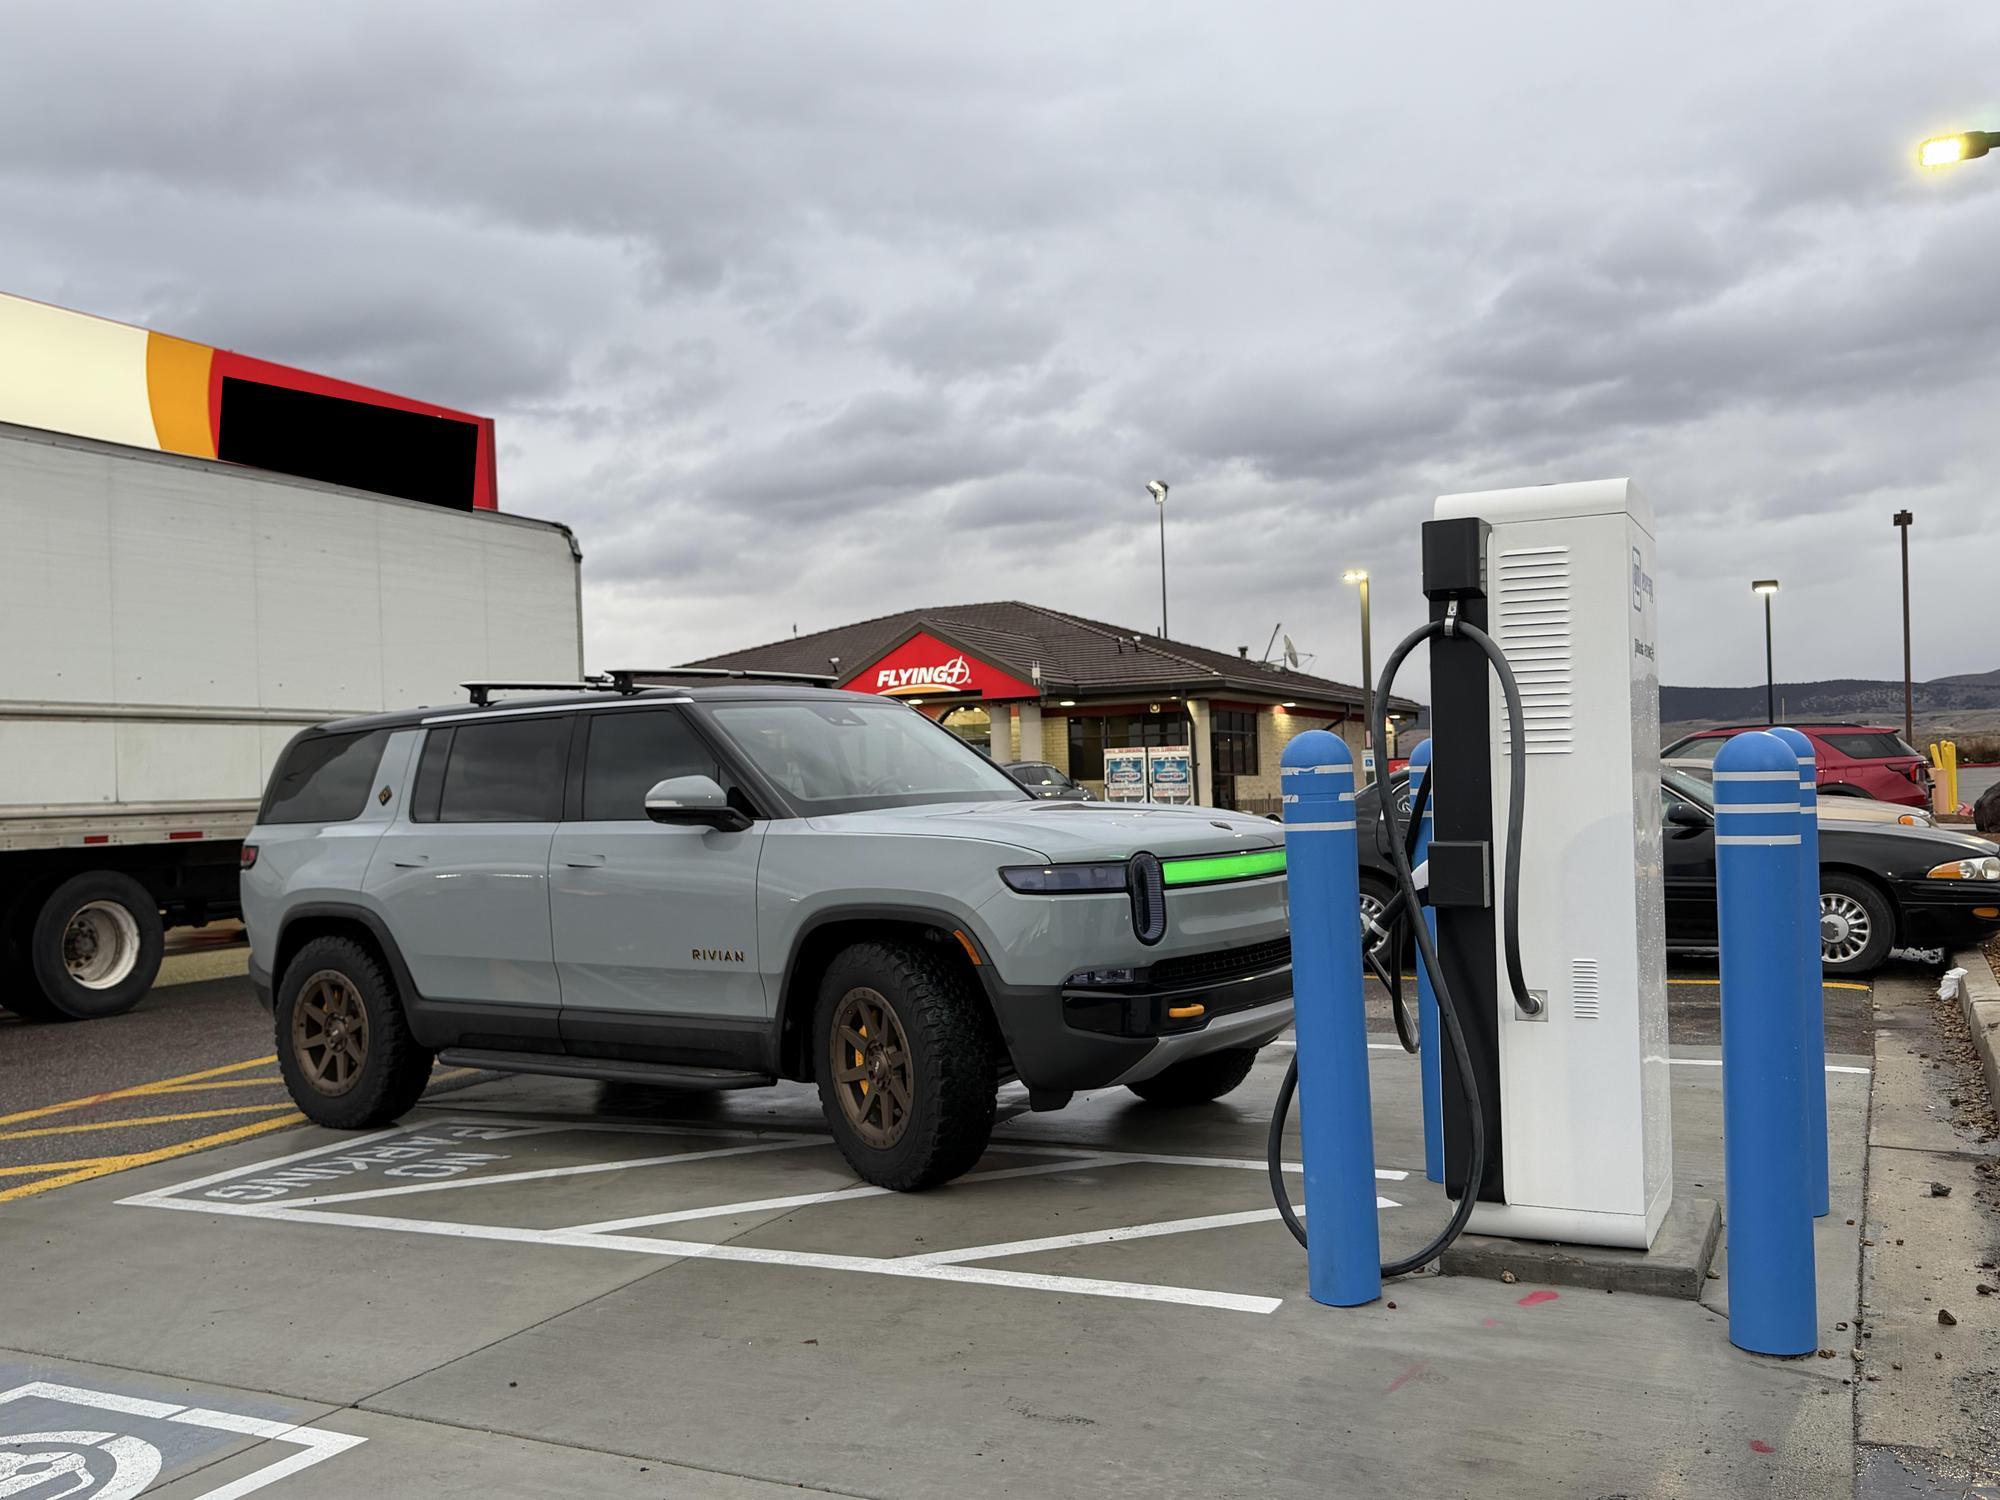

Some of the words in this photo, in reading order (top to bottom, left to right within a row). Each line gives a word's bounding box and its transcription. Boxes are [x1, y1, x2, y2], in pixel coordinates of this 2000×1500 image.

[692, 949, 744, 961] RIVIAN
[205, 1124, 510, 1200] PARKING
[384, 1152, 513, 1178] NO
